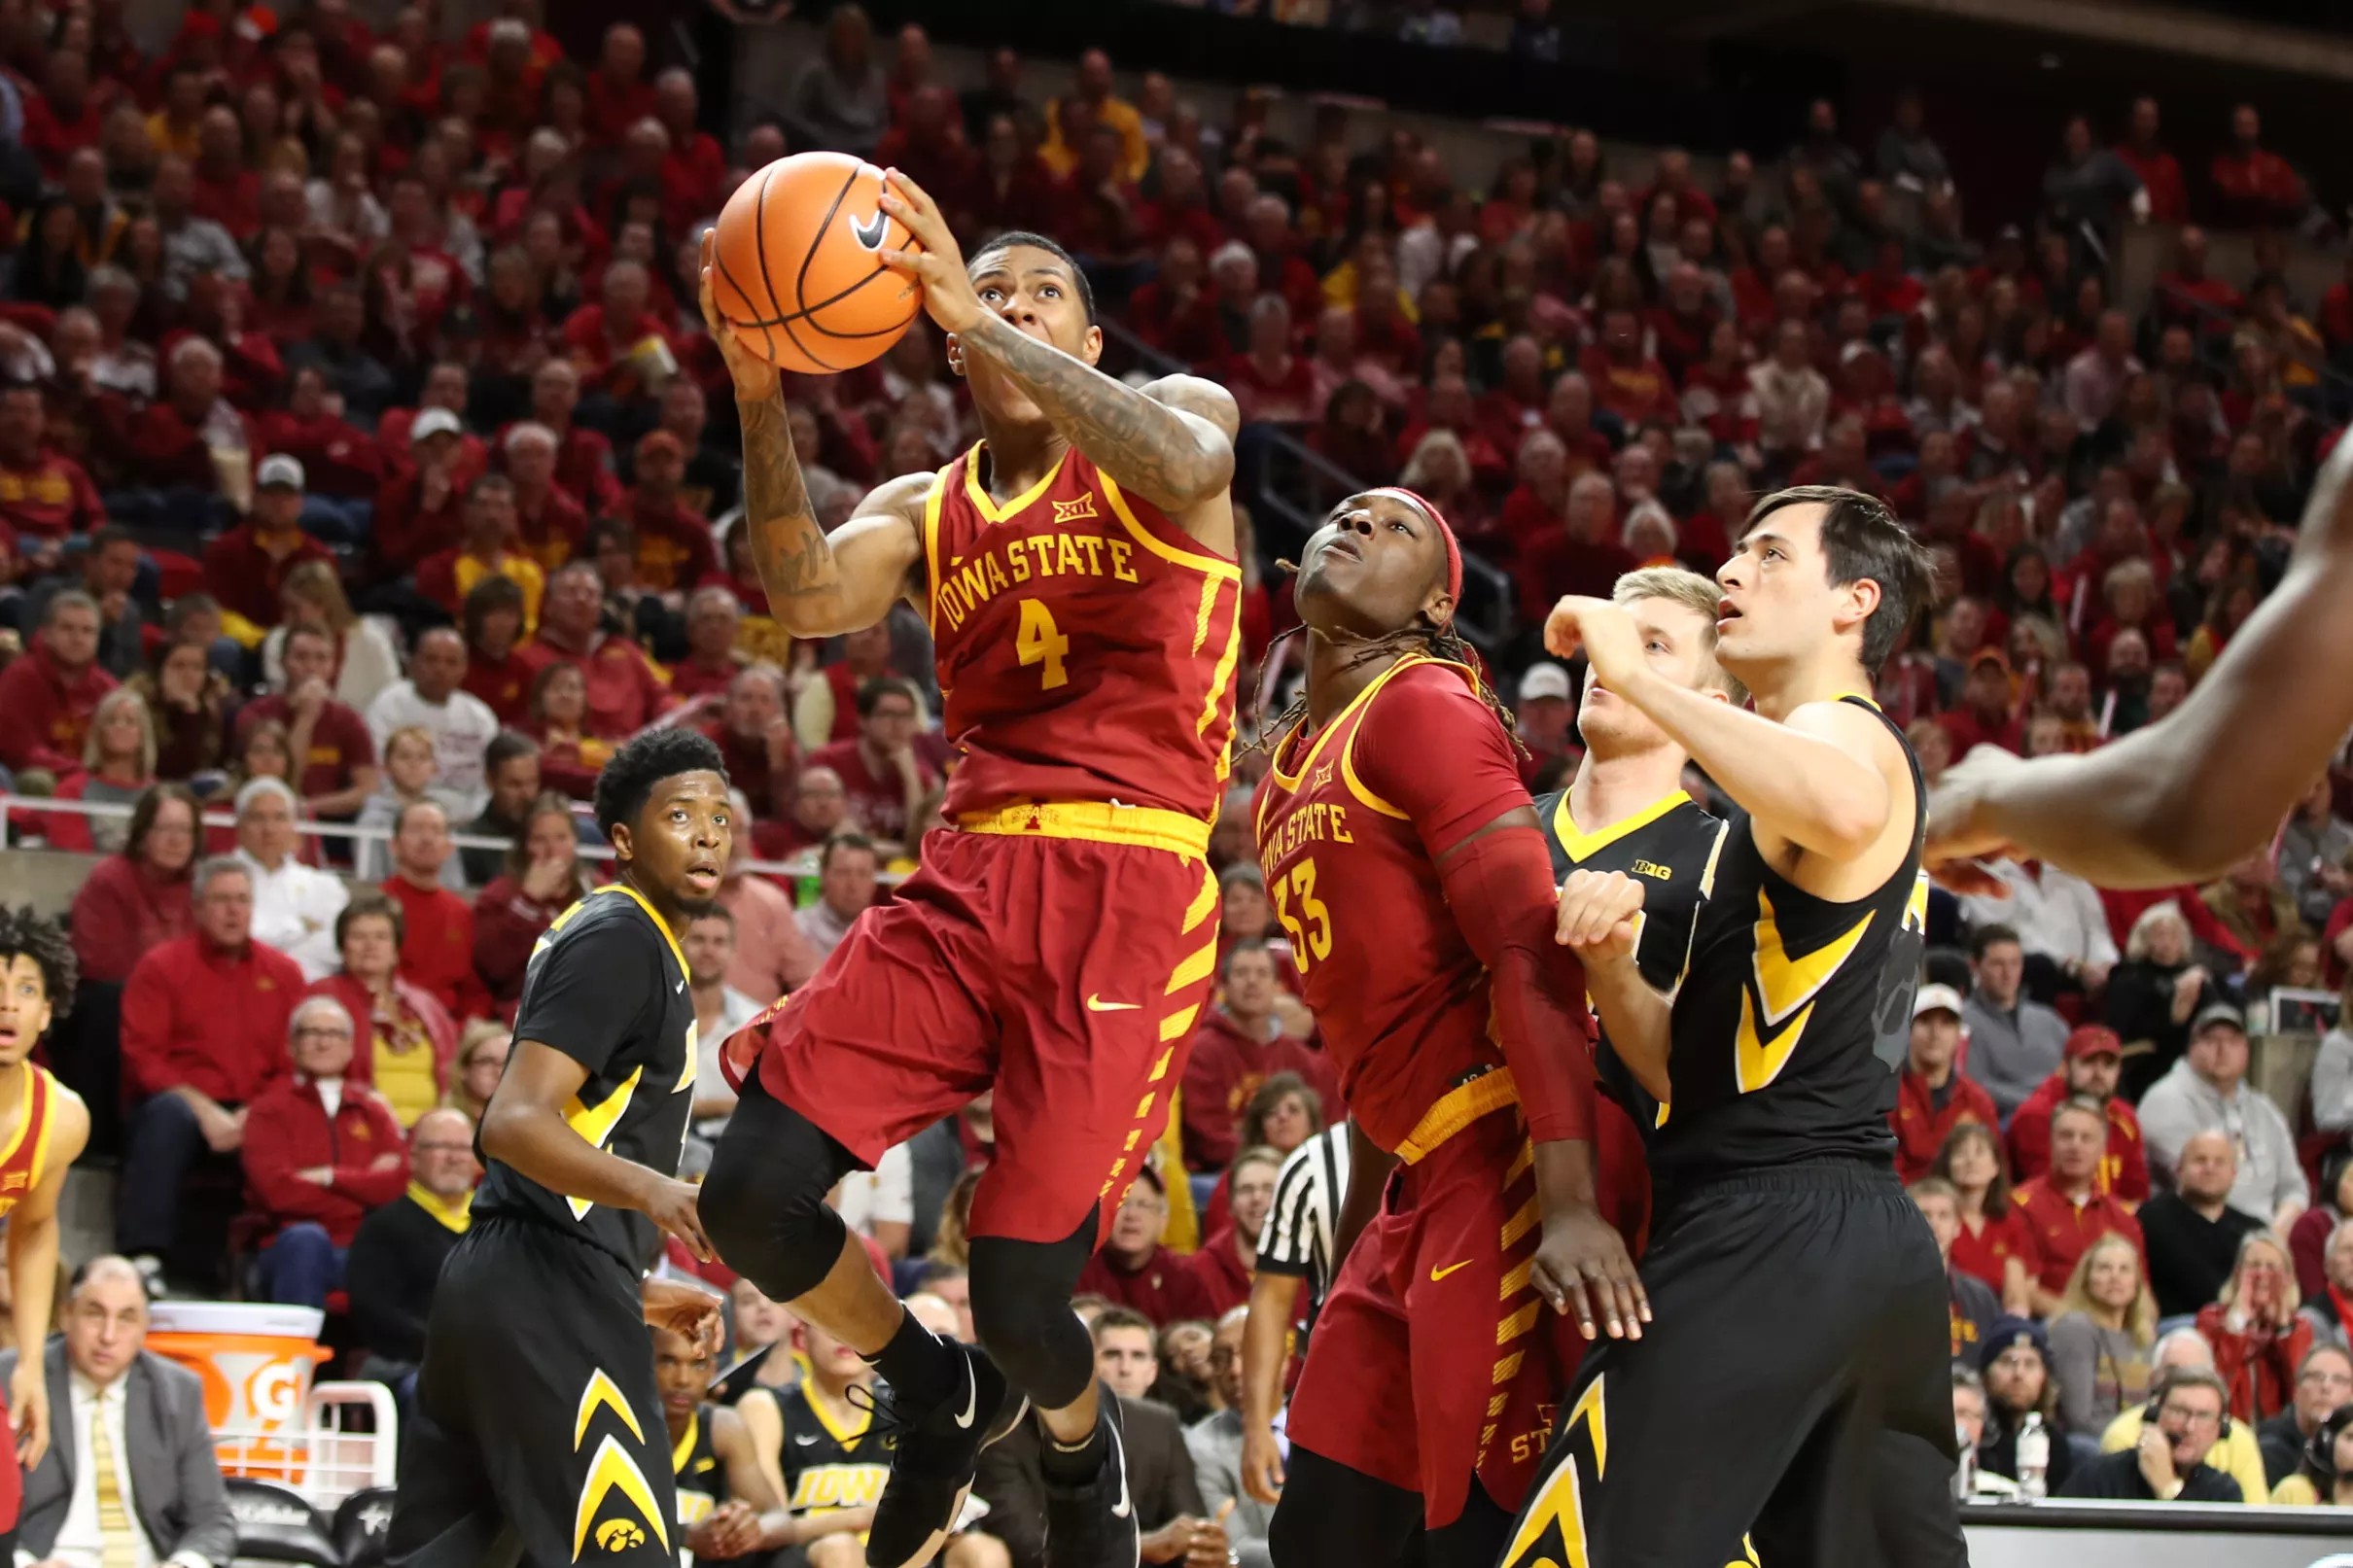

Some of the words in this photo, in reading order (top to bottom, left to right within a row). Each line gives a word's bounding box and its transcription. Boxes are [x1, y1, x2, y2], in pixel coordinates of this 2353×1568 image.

[938, 551, 1009, 632] IOWA
[1007, 534, 1139, 583] STATE
[1016, 598, 1069, 690] 4
[1261, 825, 1284, 880] WA
[1287, 803, 1354, 854] STATE
[1272, 856, 1332, 974] 33
[252, 1364, 297, 1419] G
[792, 1465, 889, 1508] IOW
